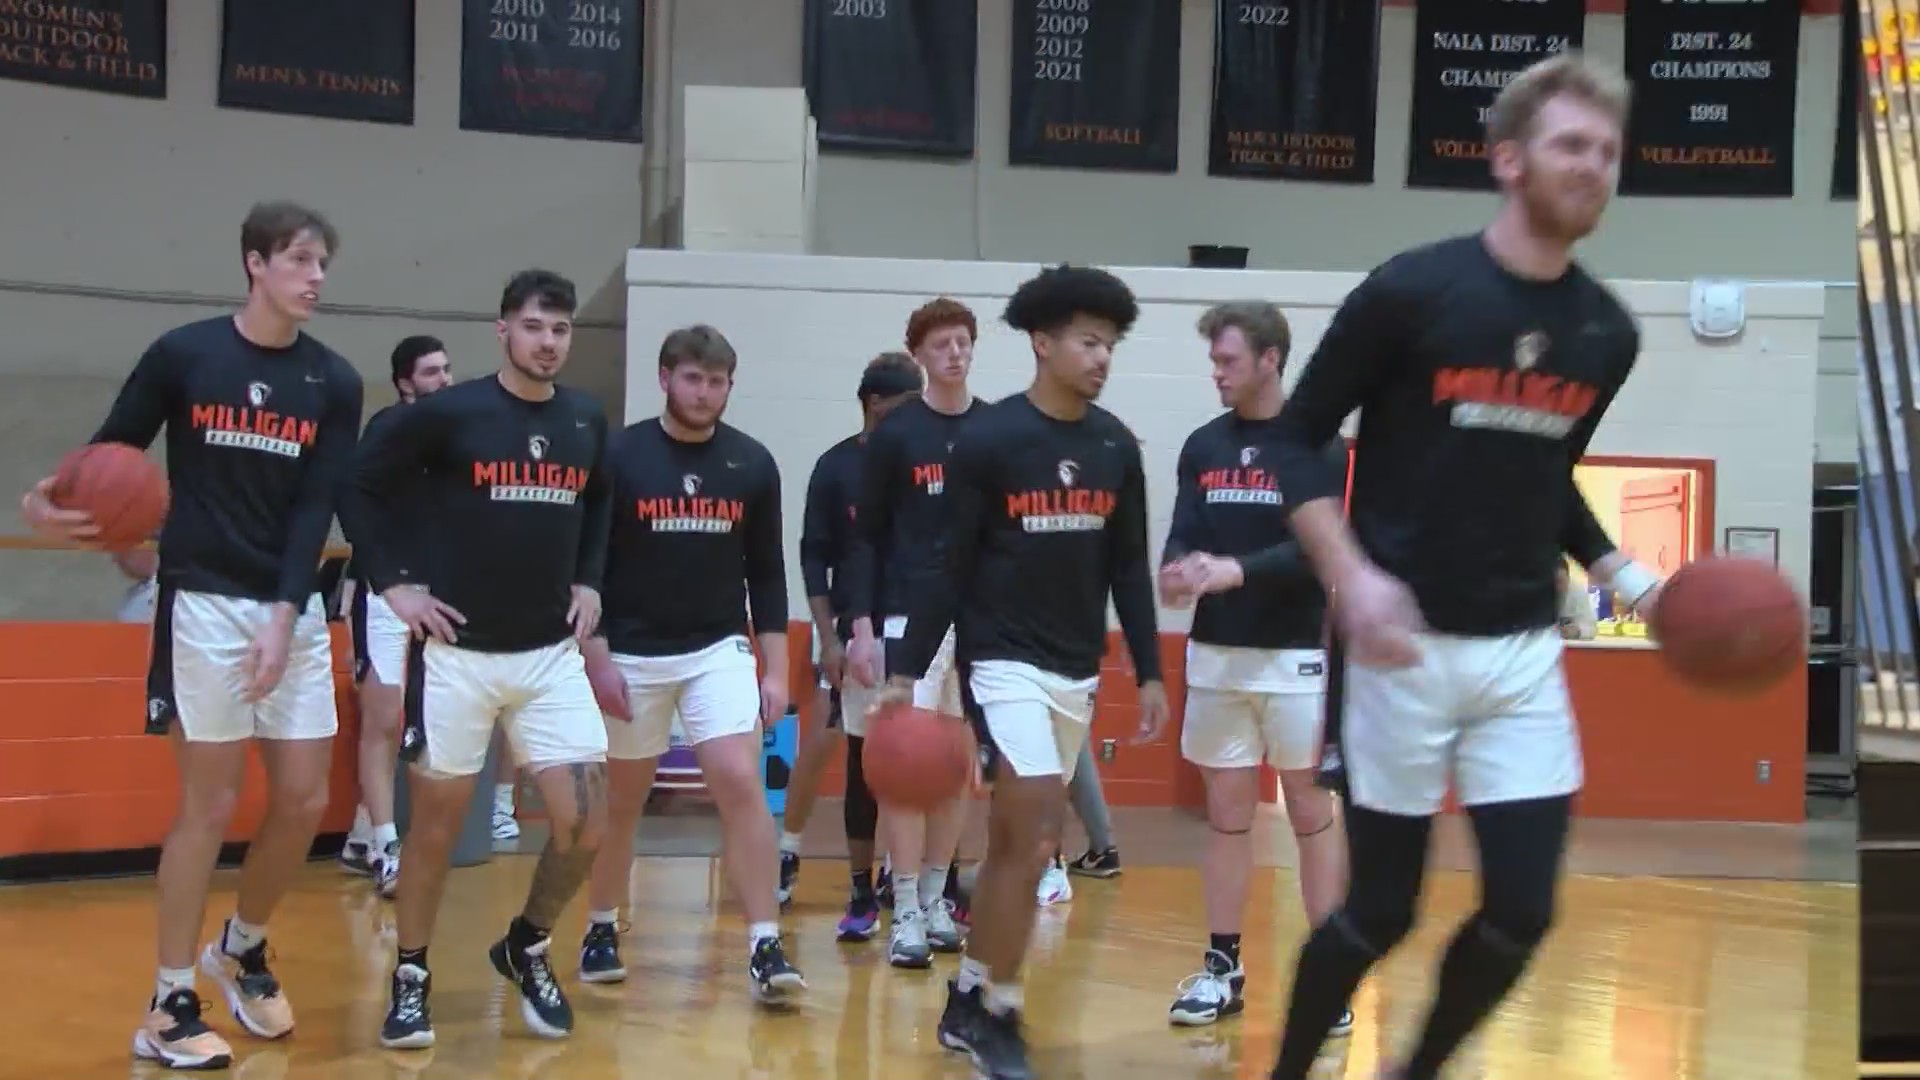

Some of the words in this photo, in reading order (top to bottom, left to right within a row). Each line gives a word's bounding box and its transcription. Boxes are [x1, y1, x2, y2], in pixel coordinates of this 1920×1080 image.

[491, 0, 545, 17] 2010
[568, 3, 621, 24] 2014
[832, 0, 887, 19] 2003
[1239, 4, 1290, 25] 2022
[489, 19, 540, 42] 2011
[568, 27, 621, 50] 2016
[1036, 13, 1089, 35] 2009
[1035, 37, 1083, 59] 2012
[1727, 32, 1753, 50] 24
[1034, 60, 1081, 81] 2021
[1689, 103, 1729, 122] 1991
[191, 403, 318, 446] MILLIGAN
[472, 460, 590, 492] MILLIGAN
[636, 498, 745, 522] MILLIGAN
